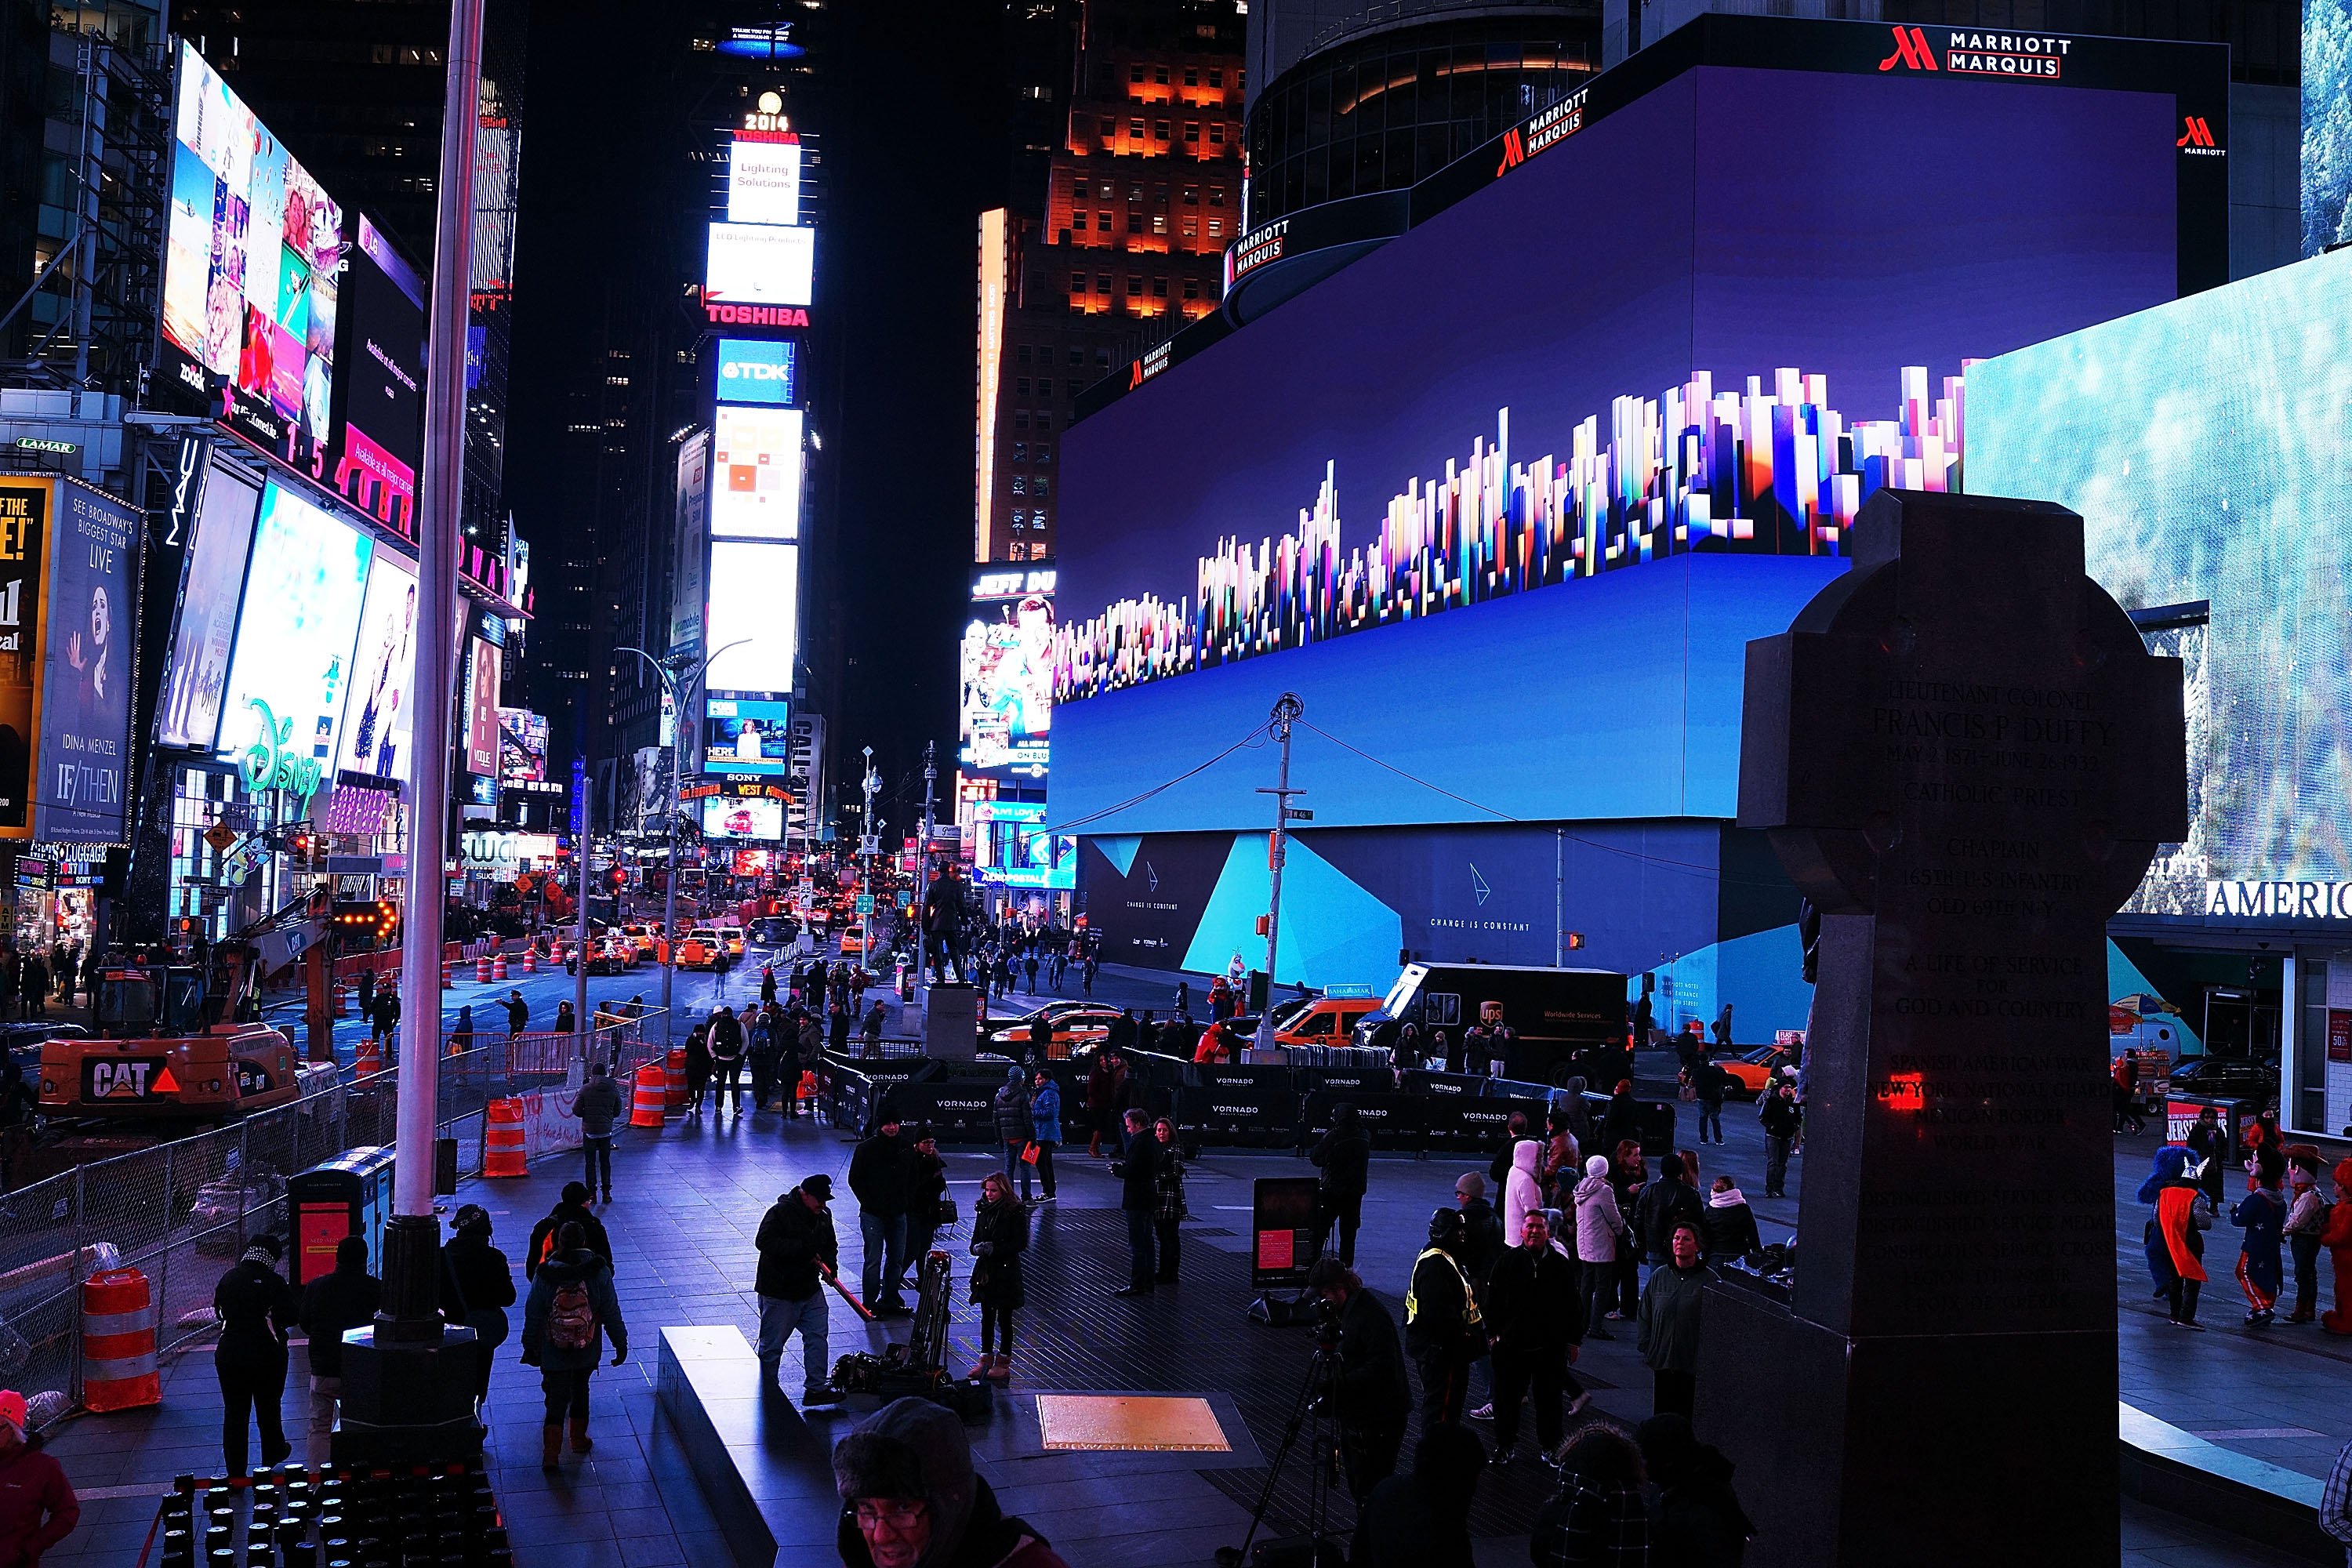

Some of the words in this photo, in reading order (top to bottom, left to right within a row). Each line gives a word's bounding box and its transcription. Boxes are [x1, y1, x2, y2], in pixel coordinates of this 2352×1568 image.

[1951, 33, 2071, 55] MARRIOTT
[1951, 55, 2056, 74] MARQUIS
[1528, 89, 1588, 135] MARRIOTT
[746, 114, 788, 132] 2014
[733, 129, 799, 144] TOSHIBA
[1529, 113, 1581, 154] MARQUIS
[742, 163, 788, 176] Lighting
[738, 177, 790, 188] Solutions
[370, 238, 378, 256] LG
[1237, 220, 1289, 256] MARRIOTT
[1236, 242, 1280, 275] MARQUIS
[706, 304, 808, 326] TOSHIBA
[1144, 341, 1172, 365] MARRIOTT
[738, 362, 789, 380] TDK
[22, 439, 71, 452] LAMAR
[287, 422, 369, 510] 1540
[355, 443, 375, 470] Available
[6, 499, 28, 516] THE
[73, 499, 86, 517] SEE
[89, 505, 133, 535] BROADWAY'S
[78, 519, 108, 541] BIGGEST
[111, 532, 126, 550] STAR
[89, 544, 113, 573] LIVE
[973, 573, 1024, 595] JEFF
[1887, 680, 2002, 706] LIEUTENANT
[2007, 688, 2094, 710] COLONEL
[1871, 707, 1985, 739] FRANCIS
[1996, 715, 2009, 741] P
[2024, 717, 2114, 746] DUFFY
[62, 734, 85, 752] IDINA
[88, 738, 117, 756] MENZEL
[793, 720, 813, 769] CALL
[1885, 746, 1922, 764] MAY
[56, 760, 118, 806] IF/THEN
[739, 785, 761, 796] WEST
[1904, 782, 2002, 804] CATHOLIC
[2013, 787, 2081, 808] PRIEST
[65, 844, 107, 863] LUGGAGE
[1946, 838, 2038, 859] CHAPLAIN
[340, 875, 365, 892] FOREVER
[1904, 866, 1953, 886] 165TH
[2002, 872, 2080, 891] INFANTRY
[1928, 898, 1965, 916] OLD
[1431, 919, 1465, 928] CHANGE
[1484, 921, 1530, 931] CONSTANT
[291, 935, 300, 951] CAT
[1905, 955, 1918, 972] A
[1927, 955, 1966, 974] LIFE
[1973, 955, 1998, 973] OF
[2007, 956, 2081, 975] SERVICE
[1977, 979, 2010, 993] FOR
[1482, 1008, 1501, 1023] ups
[1544, 1011, 1574, 1019] Worldwide
[1577, 1011, 1602, 1019] Services
[1895, 996, 1942, 1017] GOD
[1949, 999, 1990, 1017] AND
[1998, 1000, 2089, 1019] COUNTRY
[2333, 1036, 2341, 1046] 50
[93, 1062, 151, 1098] CAT
[256, 1074, 265, 1090] CAT
[1430, 1083, 1461, 1092] VORNADO
